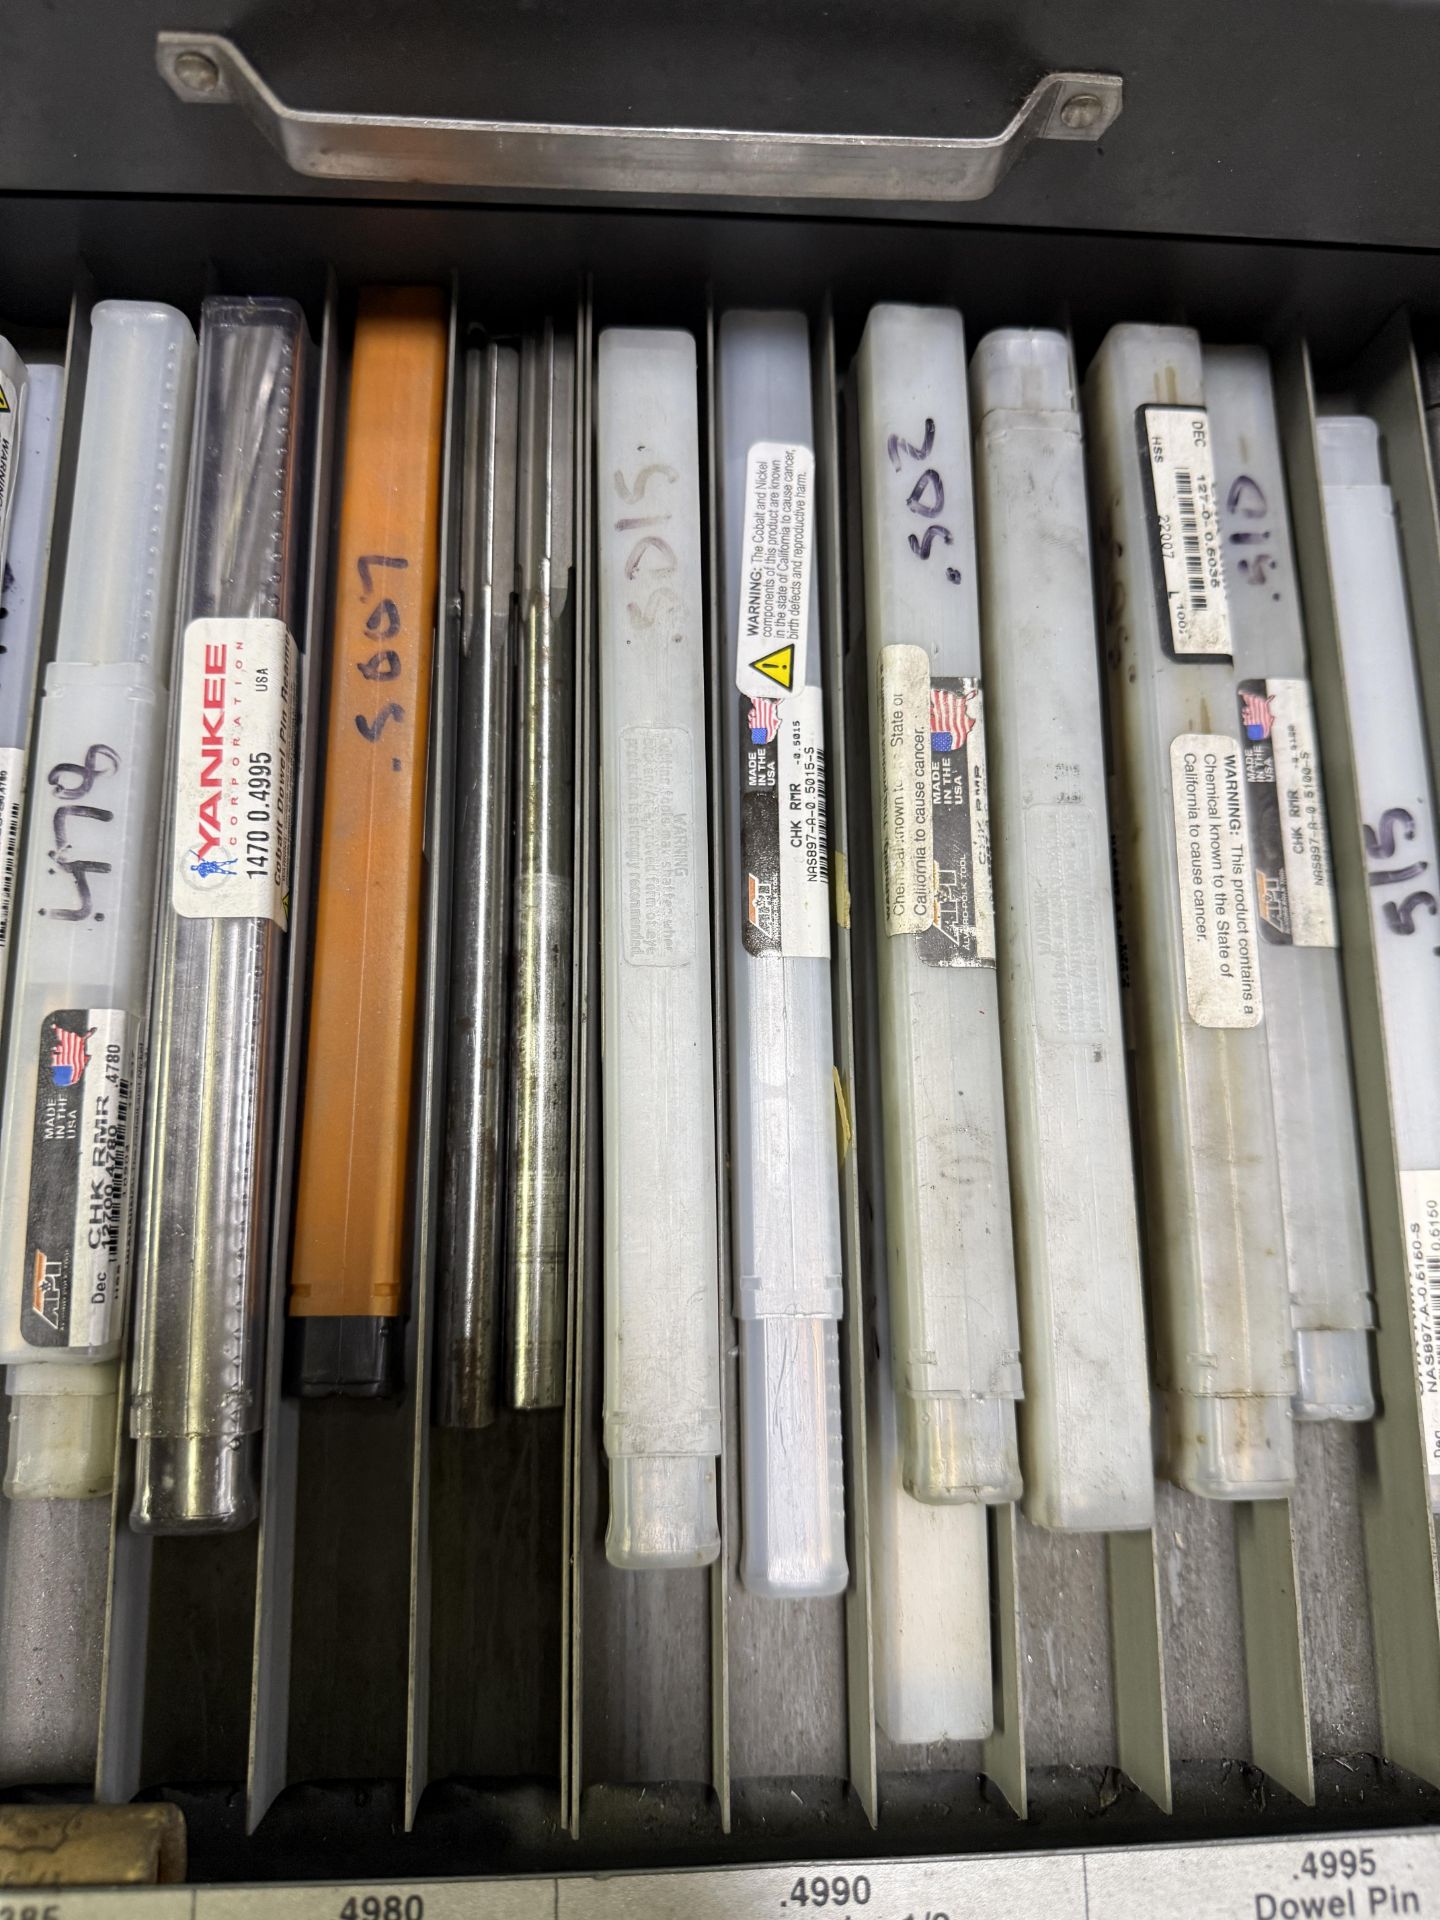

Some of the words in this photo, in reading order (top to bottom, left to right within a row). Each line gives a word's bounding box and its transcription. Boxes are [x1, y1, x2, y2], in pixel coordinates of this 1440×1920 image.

[1192, 421, 1207, 448] DEC
[1151, 437, 1164, 463] HSS
[755, 461, 767, 490] Nickel
[768, 460, 781, 490] known
[784, 449, 796, 482] cancer,
[769, 492, 779, 507] are
[782, 485, 793, 512] cause
[794, 472, 807, 498] harm.
[755, 492, 767, 510] and
[752, 512, 766, 543] Cobalt
[767, 510, 779, 545] product
[780, 515, 791, 524] to
[793, 500, 806, 558] reproductive
[750, 546, 763, 564] The
[764, 548, 776, 564] this
[776, 527, 791, 571] California
[763, 567, 775, 576] of
[776, 574, 788, 583] of
[790, 560, 803, 579] and
[747, 568, 762, 636] WARNING:
[762, 579, 775, 637] components
[776, 586, 787, 610] state
[788, 581, 801, 616] defects
[774, 612, 786, 627] the
[774, 630, 785, 639] in
[787, 619, 799, 640] birth
[255, 667, 269, 692] USA
[229, 640, 244, 846] CORPORATION
[890, 710, 904, 747] State
[198, 643, 227, 861] YANKEE
[757, 748, 767, 772] THE
[914, 726, 925, 777] cancer.
[1245, 749, 1256, 782] MADE
[1253, 745, 1265, 767] THE
[276, 749, 287, 814] Dowel
[748, 751, 757, 786] MADE
[757, 774, 767, 786] IN
[767, 761, 776, 786] USA
[931, 761, 941, 804] MADE
[942, 758, 951, 786] THE
[1255, 771, 1266, 782] IN
[1263, 757, 1275, 782] USA
[247, 752, 272, 822] 0.4995
[789, 783, 802, 810] RMR
[943, 787, 951, 804] IN
[953, 775, 963, 804] USA
[1183, 753, 1201, 820] California
[1203, 753, 1221, 820] Chemical
[1224, 755, 1241, 836] WARNING:
[804, 746, 818, 882] NAS897-A-0.5015-S
[915, 781, 926, 824] cause
[1287, 789, 1301, 818] RMR
[673, 813, 688, 877] WARNING
[790, 820, 802, 848] CHK
[913, 828, 926, 842] to
[1189, 824, 1201, 838] to
[1290, 826, 1305, 854] CHK
[246, 830, 270, 879] 1470
[274, 819, 284, 886] Cobalt
[1208, 824, 1223, 870] known
[1230, 844, 1245, 875] This
[1190, 842, 1204, 885] cause
[1212, 875, 1226, 889] to
[1193, 889, 1208, 943] cancer.
[1214, 893, 1228, 916] the
[1230, 879, 1249, 934] product
[1215, 920, 1230, 959] State
[1219, 963, 1234, 979] of
[1237, 939, 1254, 1001] contains
[1243, 1006, 1254, 1015] a
[104, 1044, 121, 1088] .4780
[44, 1097, 57, 1139] MADE
[54, 1125, 66, 1139] IN
[66, 1109, 78, 1139] USA
[92, 1095, 109, 1167] RMR
[88, 1178, 104, 1249] CHK
[91, 1271, 108, 1304] Dec
[1293, 1849, 1376, 1880] .4995
[780, 1875, 871, 1907] .4990
[1255, 1888, 1356, 1920] Dowel
[1368, 1885, 1421, 1916] Pin
